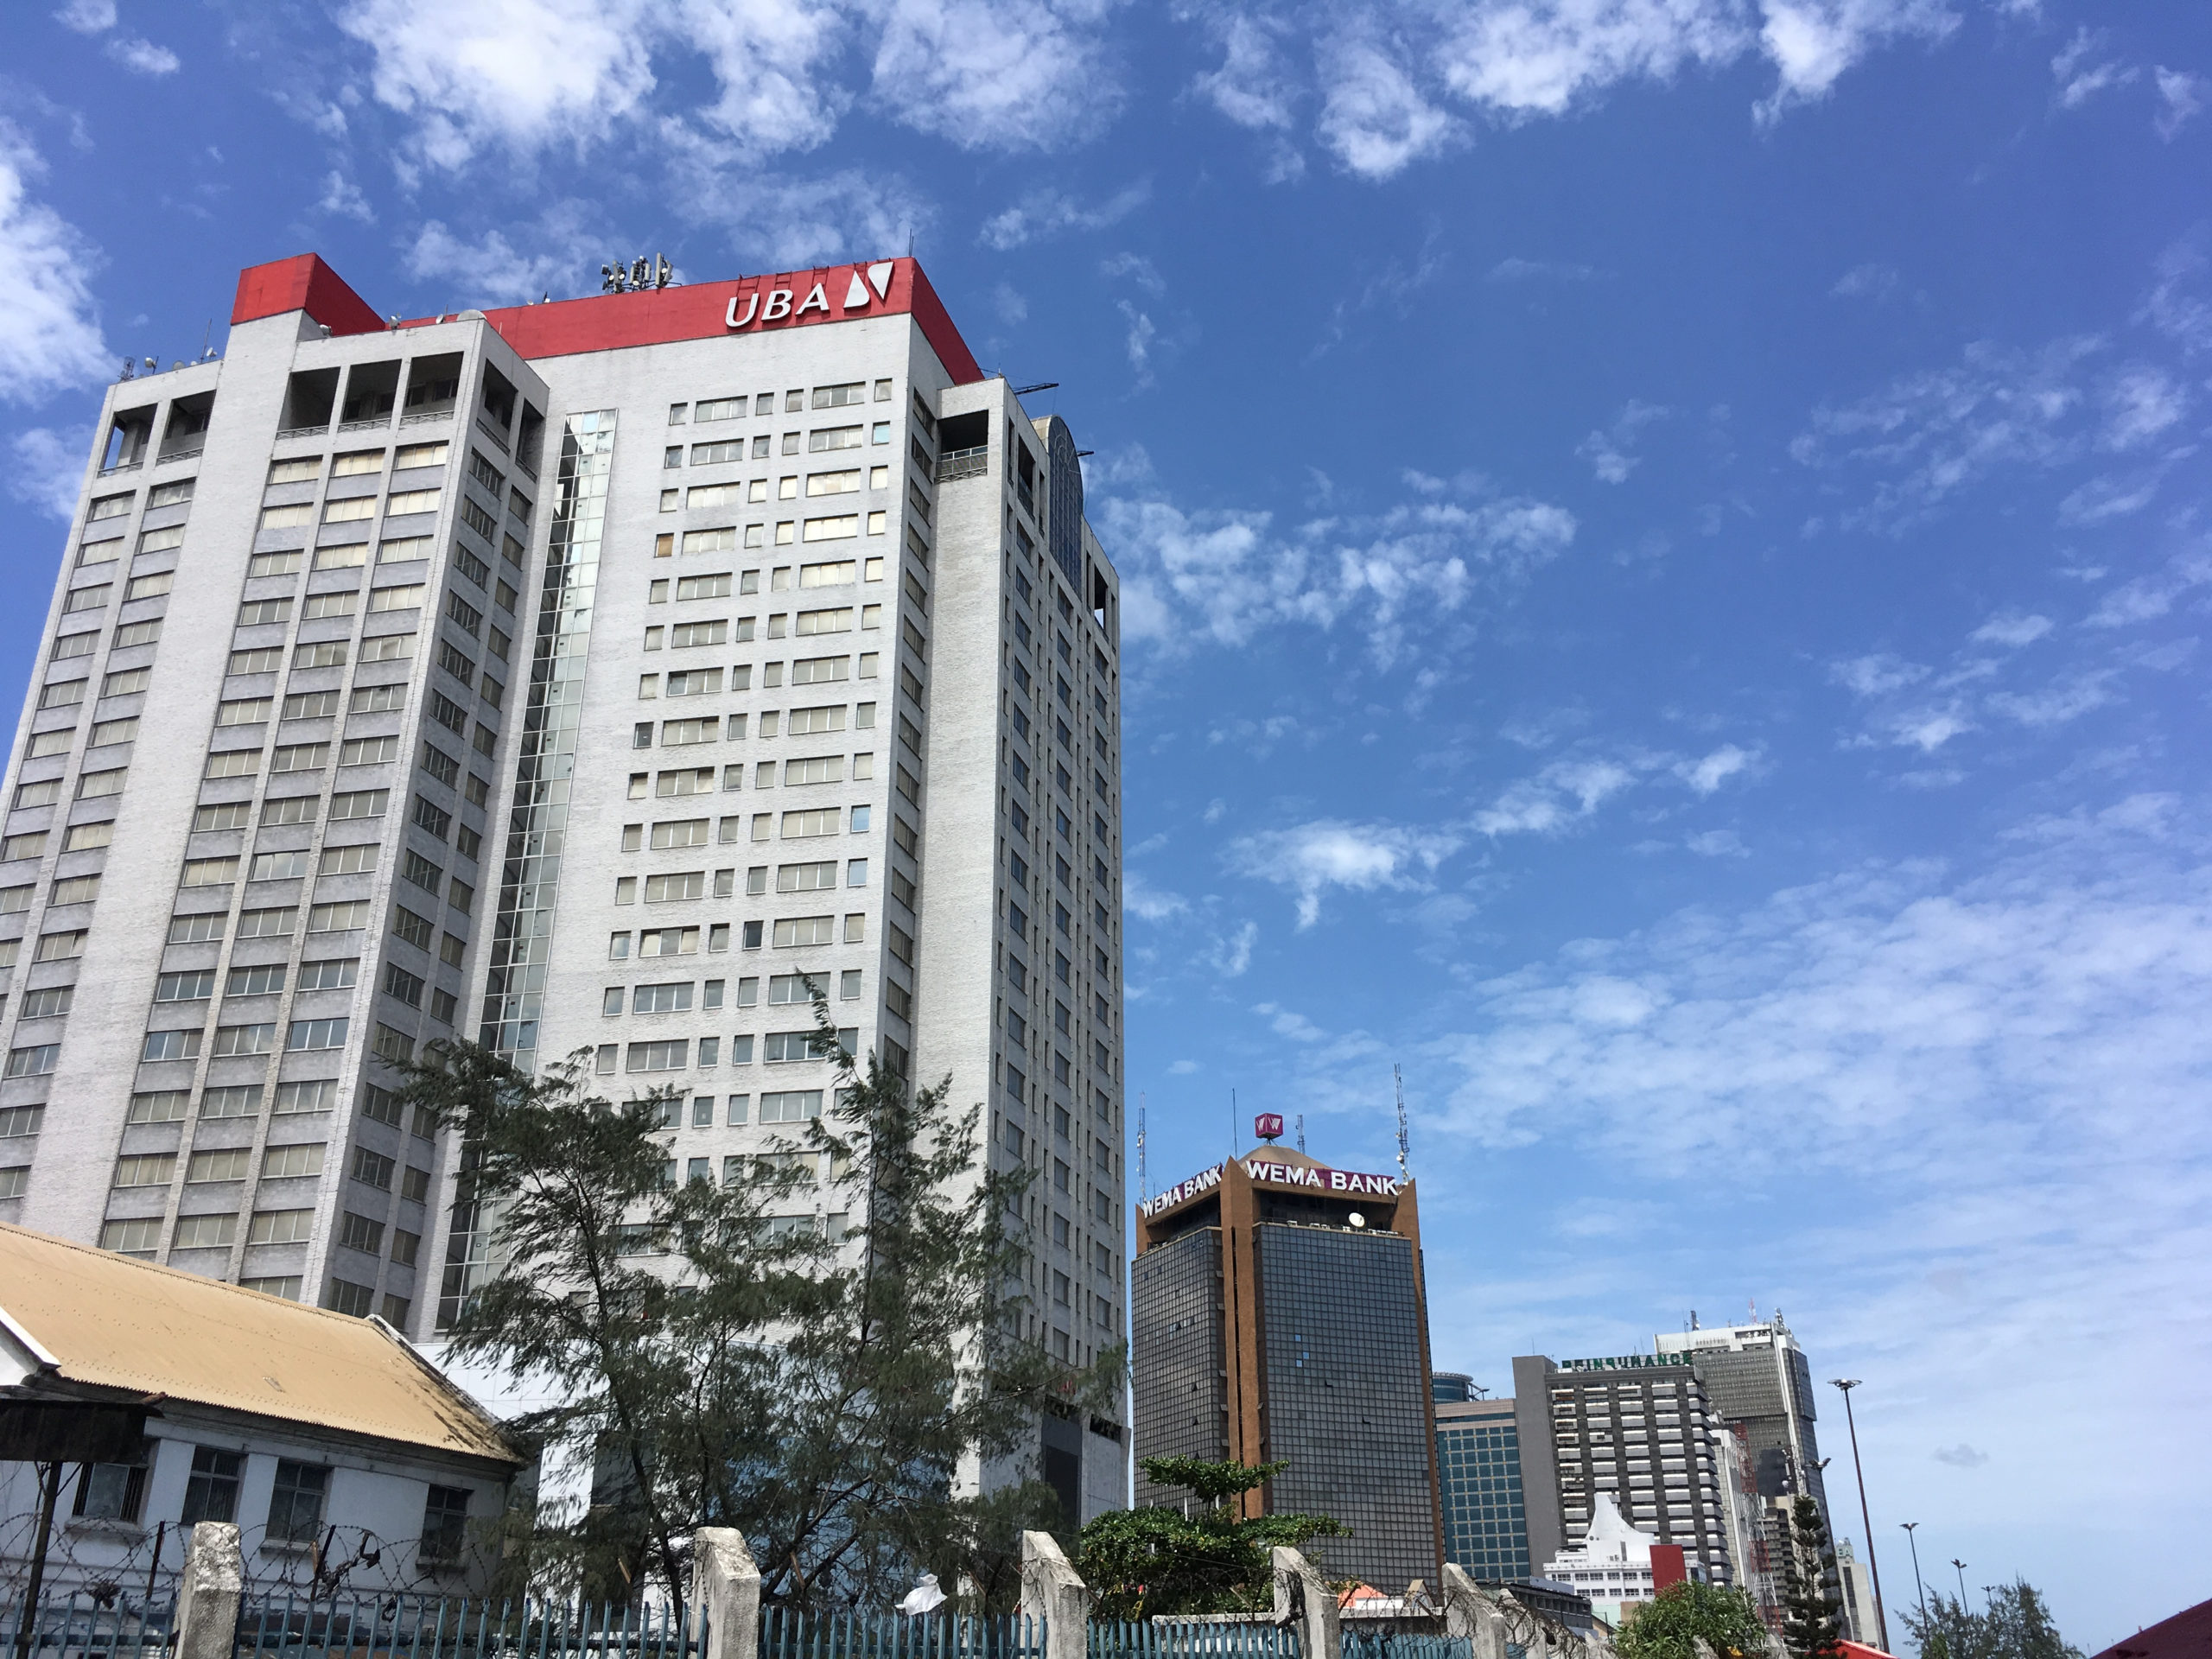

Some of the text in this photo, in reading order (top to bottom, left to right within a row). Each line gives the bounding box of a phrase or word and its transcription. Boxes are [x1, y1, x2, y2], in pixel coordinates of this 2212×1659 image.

[725, 283, 830, 327] UBA
[1142, 1165, 1222, 1218] WEMA BANK
[1246, 1160, 1398, 1196] WEMA BANK
